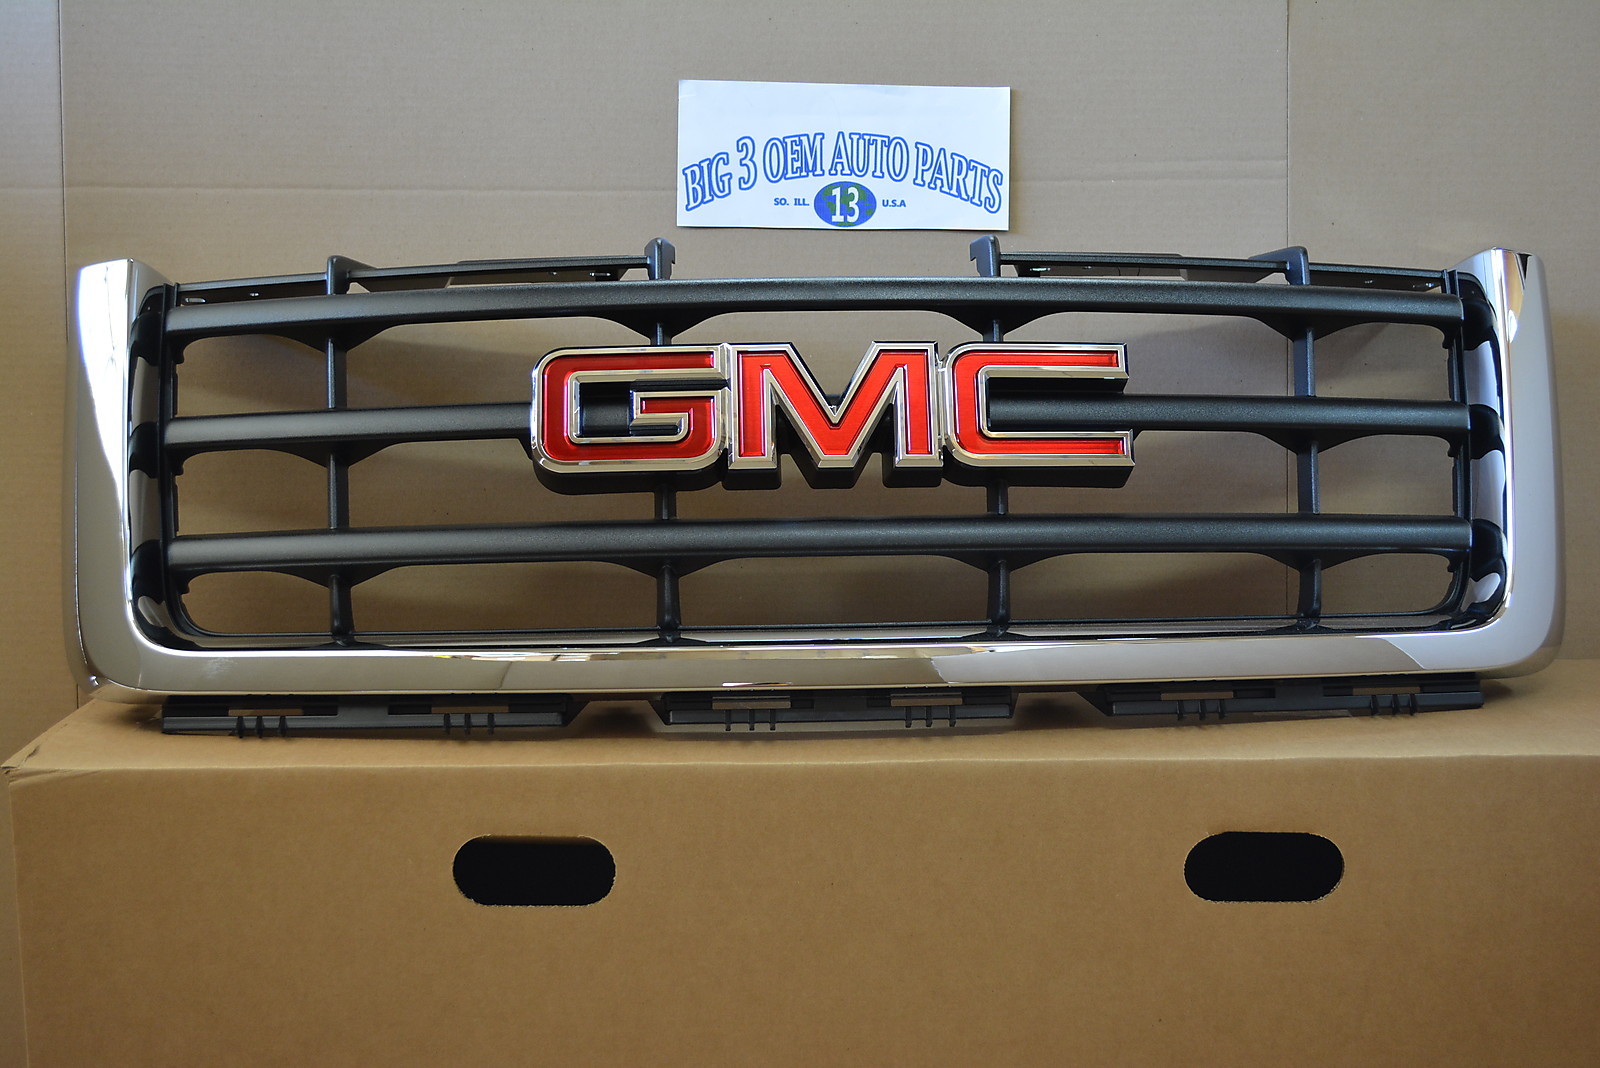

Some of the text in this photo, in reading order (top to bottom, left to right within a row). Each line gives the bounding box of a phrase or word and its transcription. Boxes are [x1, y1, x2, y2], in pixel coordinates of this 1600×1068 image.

[682, 131, 1003, 214] BIG 3 OEM AUTO PARTS
[773, 198, 810, 206] SO. ILL.
[831, 186, 860, 223] 13
[882, 199, 906, 207] U.S.A
[531, 341, 1135, 476] GMC
